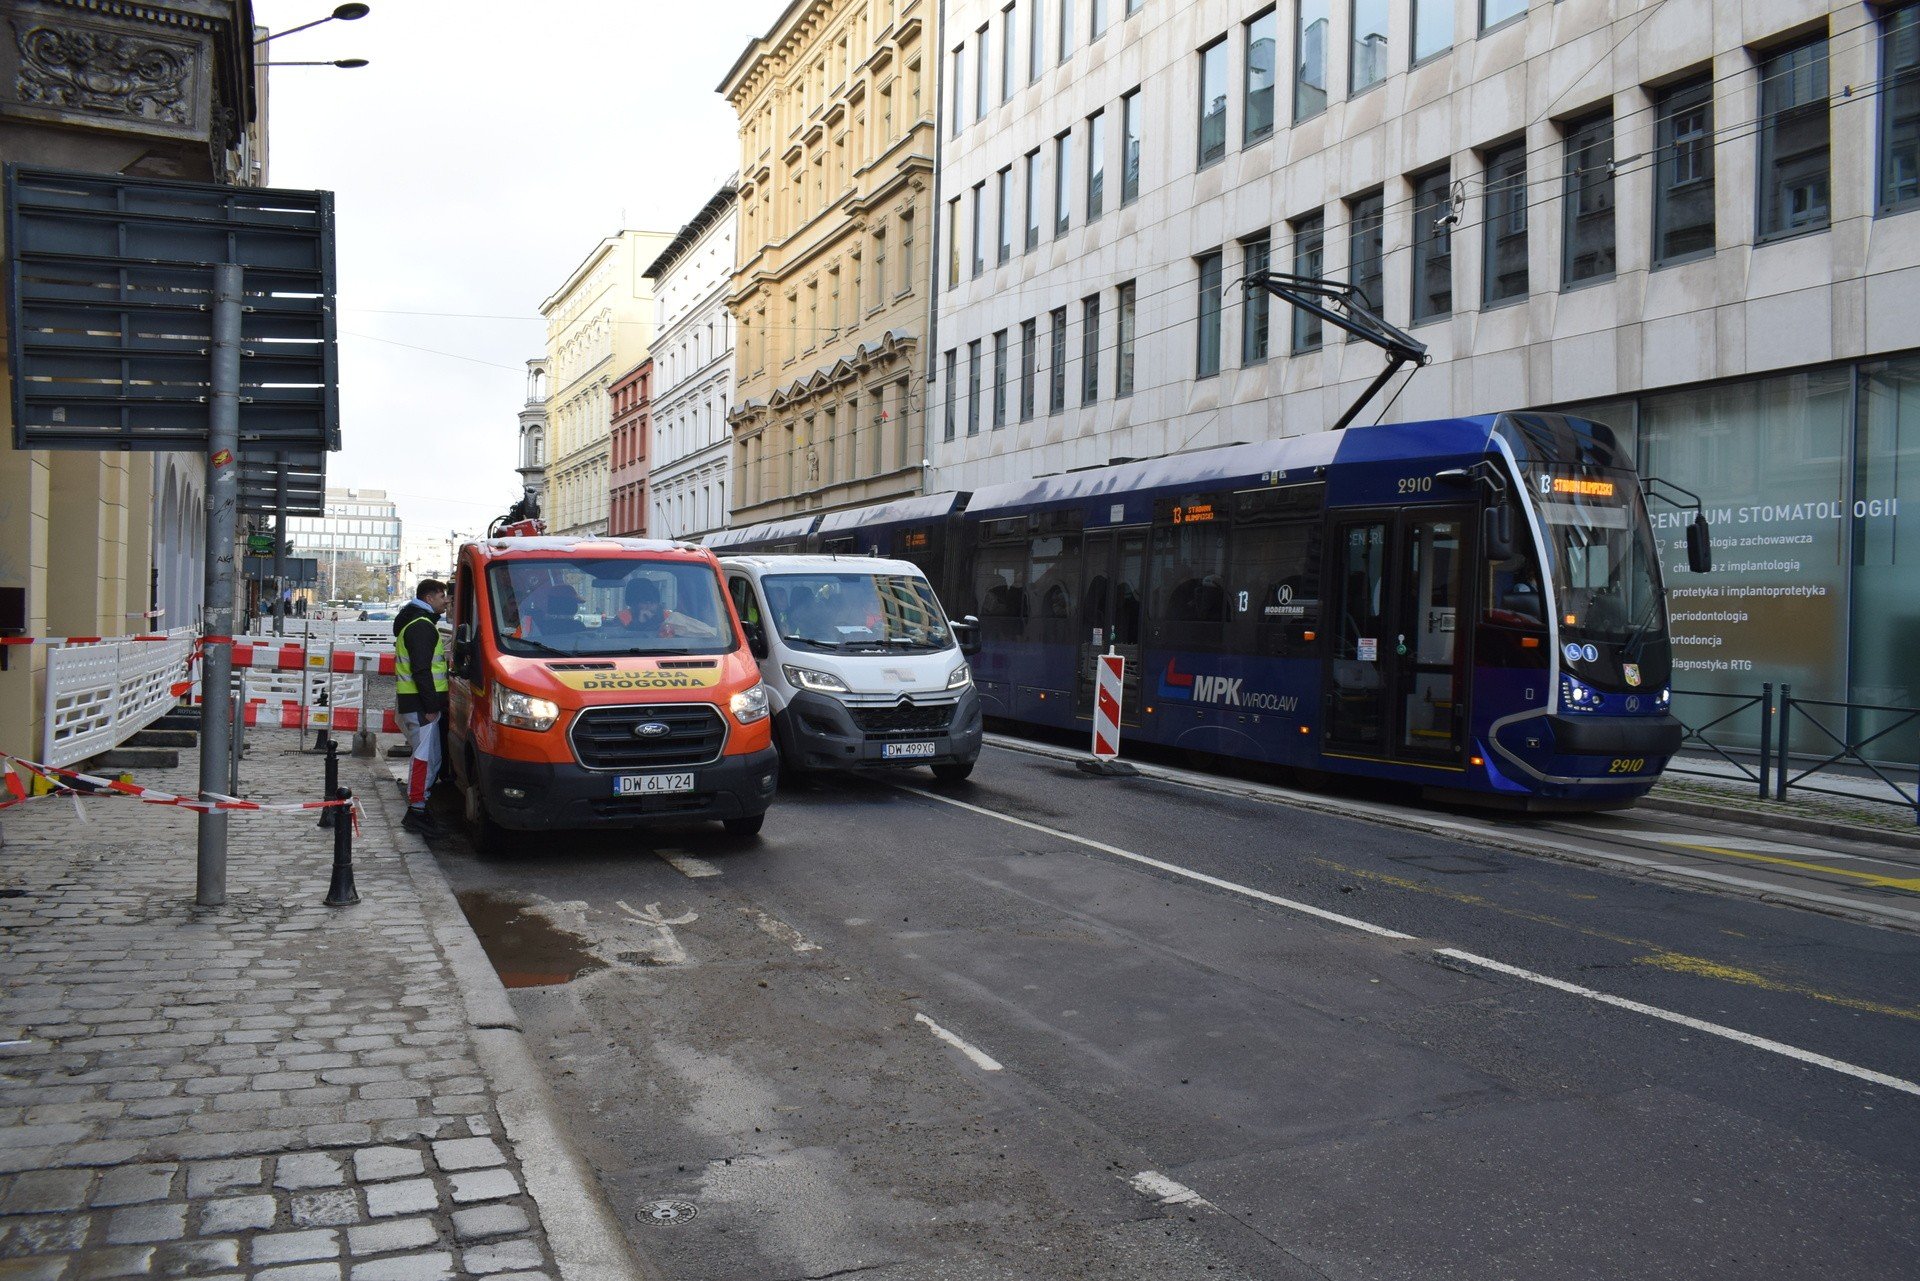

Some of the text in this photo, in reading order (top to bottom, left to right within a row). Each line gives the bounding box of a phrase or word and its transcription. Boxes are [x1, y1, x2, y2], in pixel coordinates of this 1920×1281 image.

[1397, 476, 1432, 493] 2910
[1540, 474, 1551, 494] 13
[1173, 506, 1182, 524] 13
[1740, 534, 1813, 546] zachowawcza
[1719, 563, 1726, 571] z
[1727, 559, 1800, 574] implantologią
[1672, 586, 1719, 599] protetyka
[1726, 585, 1826, 598] implantoprotetyka
[1239, 590, 1249, 612] 13
[1670, 611, 1748, 623] periodontologia
[1670, 635, 1722, 647] ortodoncja
[1731, 660, 1752, 671] RTG
[594, 670, 689, 680] SŁUŻBA
[583, 678, 706, 689] DROGOWA
[1193, 675, 1298, 712] MPK WROCŁAW
[888, 742, 935, 755] DW 499XG
[1608, 758, 1644, 773] 2910
[623, 777, 641, 791] DW
[647, 774, 691, 790] 6LY24
